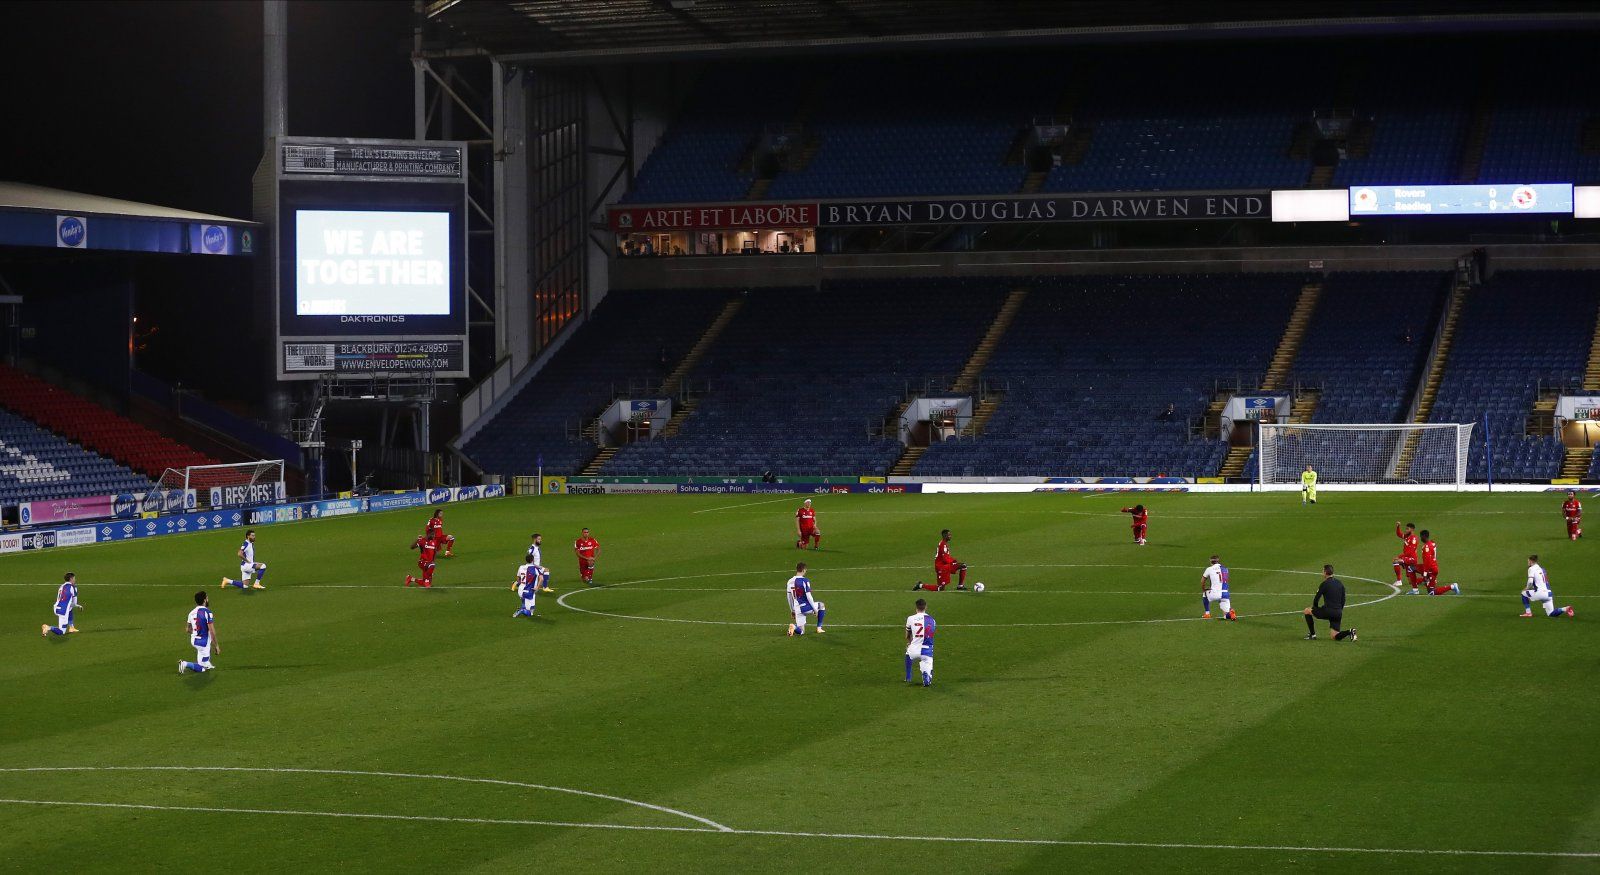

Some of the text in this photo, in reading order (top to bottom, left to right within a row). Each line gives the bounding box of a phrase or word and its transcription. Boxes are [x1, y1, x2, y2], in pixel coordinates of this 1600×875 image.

[351, 149, 363, 158] THE
[336, 162, 388, 172] MANUFACTURER
[395, 163, 424, 172] PRINTING
[425, 164, 455, 173] COMPANY
[1394, 188, 1496, 198] Rovers 0
[828, 197, 1263, 223] BRYAN DOUGLAS DARWEN END
[1394, 200, 1496, 212] Reading 0
[642, 206, 809, 228] ARTE ET LABORE
[324, 230, 424, 255] WE ARE
[302, 260, 444, 285] TOGETHER
[342, 344, 448, 354] BLACKBURN: 01254 428950
[342, 359, 448, 368] WWW.ENVELOPEWORKS.COM
[566, 485, 606, 494] Telegraph
[431, 490, 449, 502] Venky's
